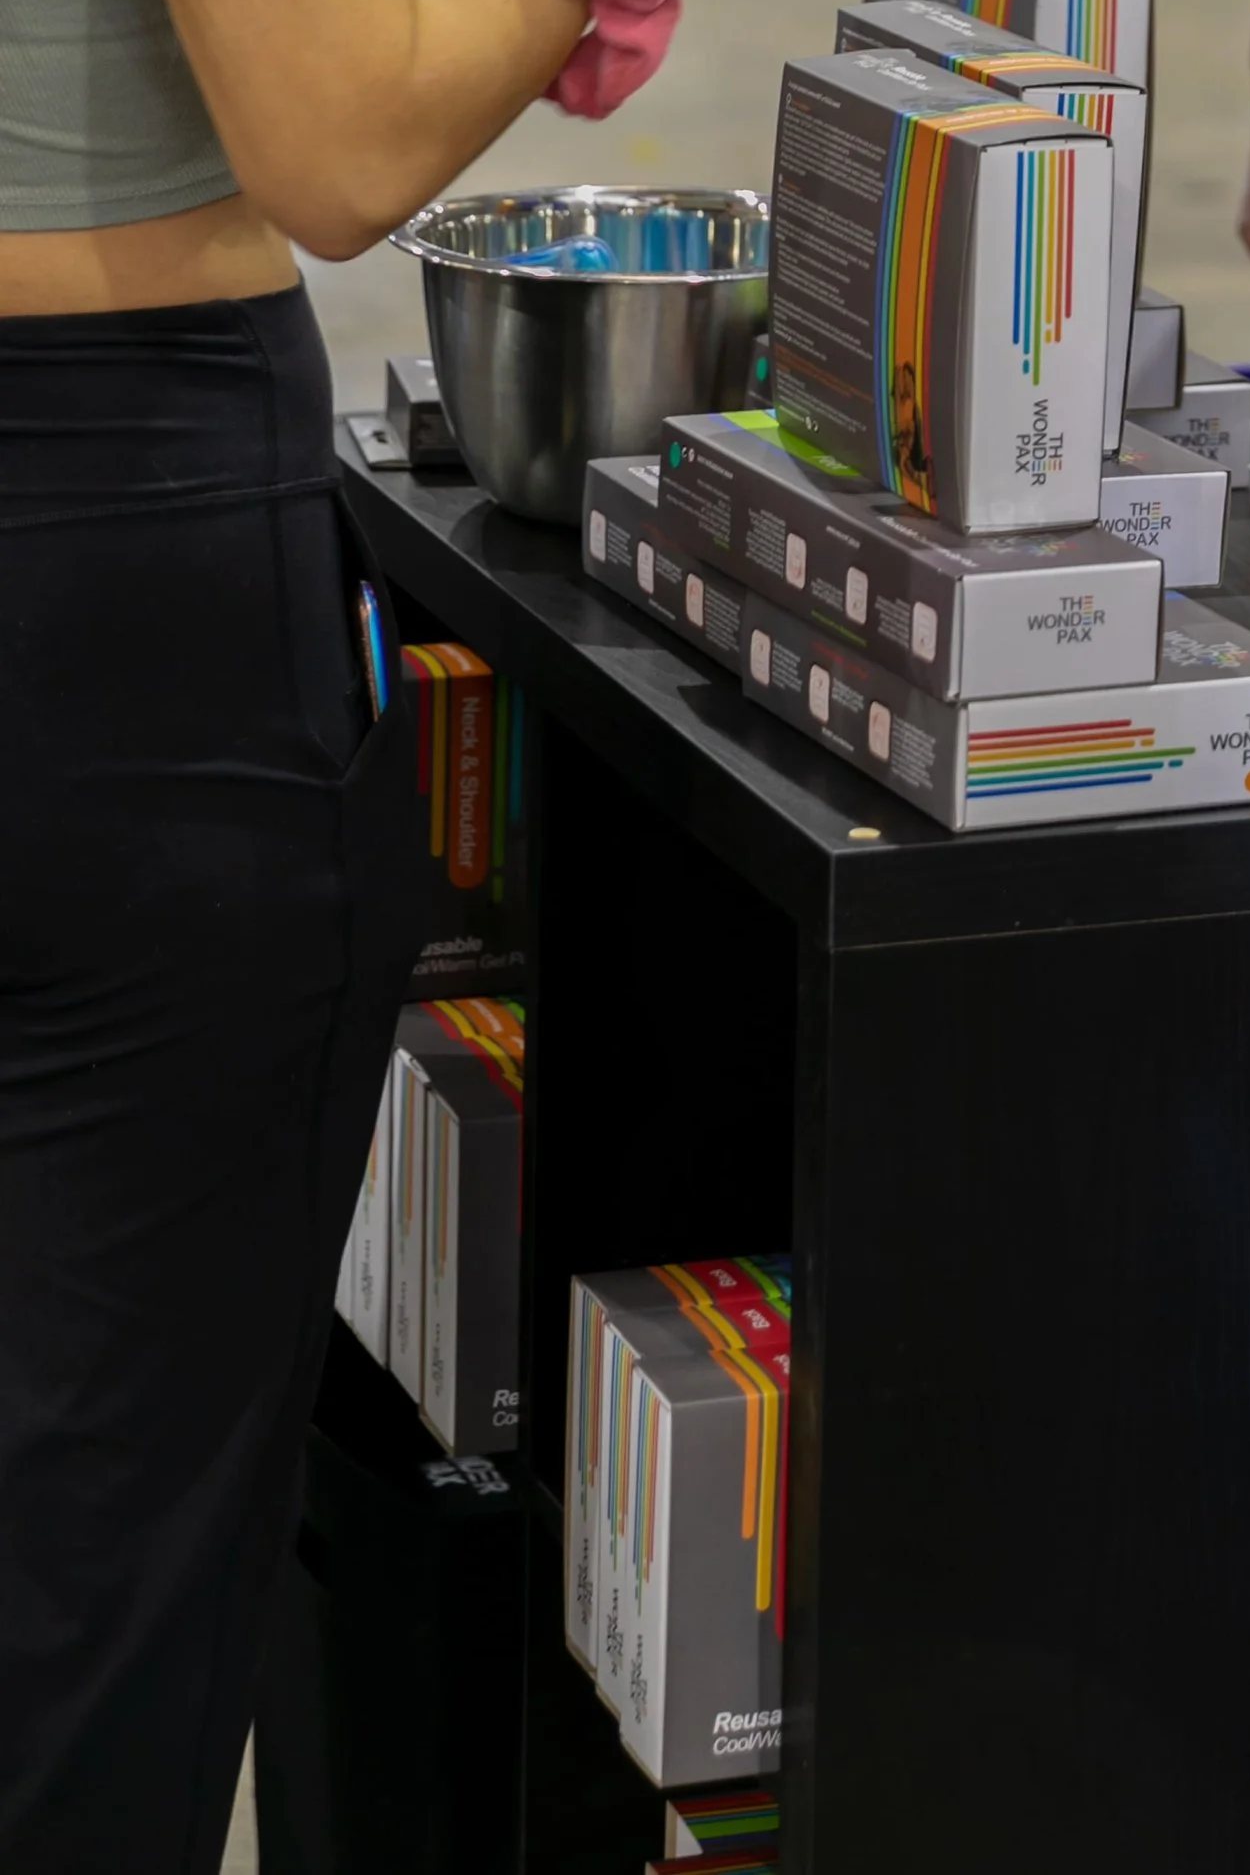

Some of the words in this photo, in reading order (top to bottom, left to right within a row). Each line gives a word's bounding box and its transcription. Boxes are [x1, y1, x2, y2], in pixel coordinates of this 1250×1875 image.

[1015, 434, 1031, 474] PAX
[1031, 399, 1049, 486] WONDER
[1049, 432, 1064, 471] THE
[1129, 501, 1162, 516] THE
[1127, 531, 1160, 547] PAX
[1060, 595, 1094, 611] THE
[1028, 608, 1105, 630] WONDER
[1057, 627, 1092, 644] PAX
[460, 695, 481, 751] Neck
[457, 776, 480, 870] Shoulder
[712, 1708, 782, 1734] Reusa
